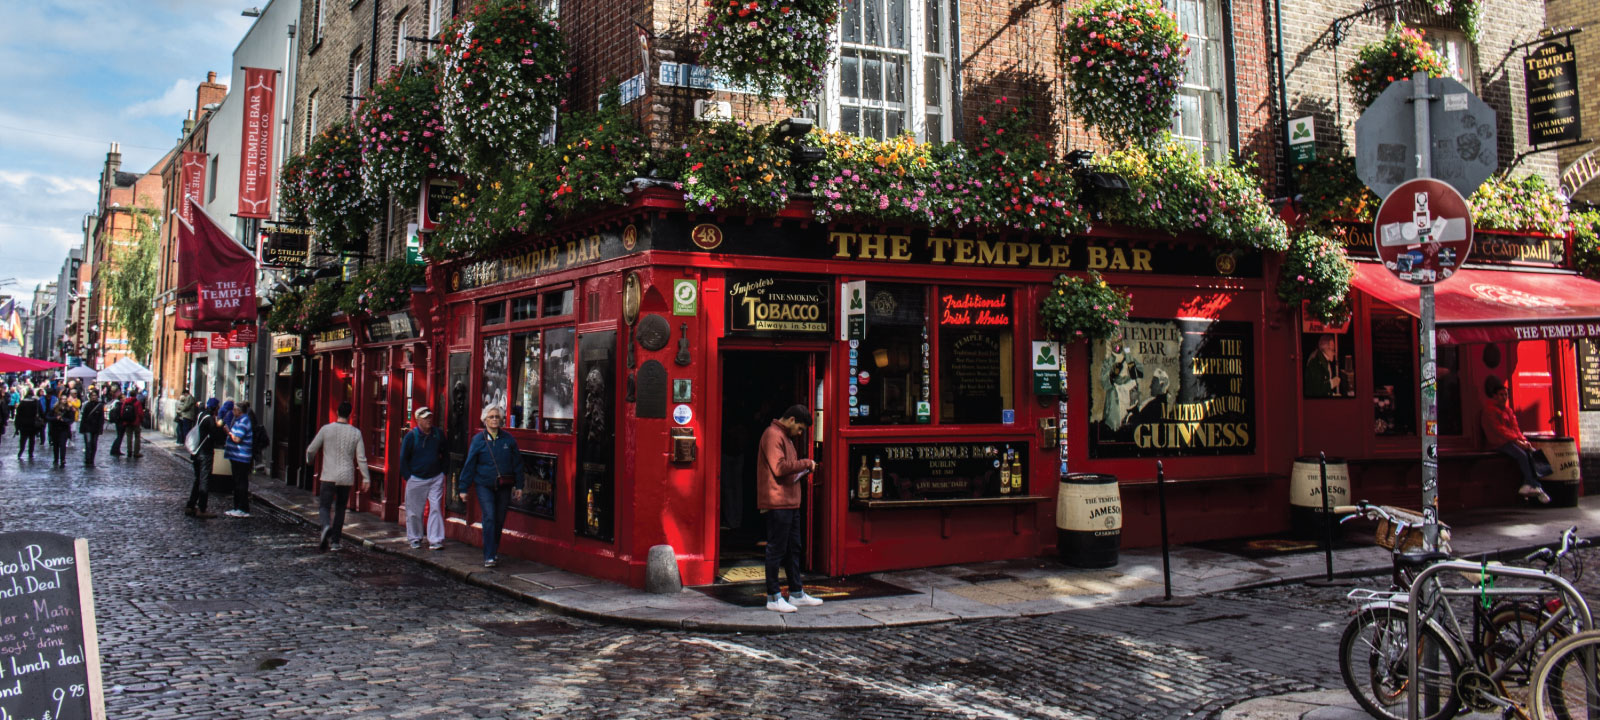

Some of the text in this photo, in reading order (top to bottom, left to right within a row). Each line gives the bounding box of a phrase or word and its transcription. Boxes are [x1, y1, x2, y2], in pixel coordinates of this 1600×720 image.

[1541, 46, 1556, 56] THE
[1526, 51, 1574, 71] TEMPLE
[1538, 67, 1563, 81] BAR
[1529, 89, 1575, 105] BEER GARDEN
[1533, 116, 1575, 130] LIVE MUSIC
[1542, 126, 1565, 136] DAILY
[246, 95, 260, 193] THE TEMPLE BAR
[259, 131, 268, 176] TRADING
[192, 170, 201, 188] THE
[1564, 154, 1600, 193] THE
[183, 183, 191, 217] TRDING
[698, 228, 716, 243] 48
[270, 248, 309, 257] DSTILLER
[503, 246, 560, 279] TEMPLE
[566, 234, 600, 266] BAR
[829, 232, 1153, 271] THE TEMPLE BAR
[216, 281, 237, 289] THE
[730, 278, 774, 296] Importers
[201, 287, 251, 300] TEMPLE
[769, 293, 819, 302] FINE SMOKING
[942, 293, 1007, 309] Traditional
[215, 299, 240, 309] BAR
[741, 296, 819, 326] TOBACCO
[941, 309, 1009, 325] Irish Music
[757, 321, 787, 331] Always
[801, 322, 825, 330] Stock
[1120, 327, 1178, 341] TEMPLE
[1514, 326, 1539, 339] THE
[1540, 324, 1586, 338] TEMPLE
[1139, 342, 1166, 356] BAR
[1220, 339, 1242, 356] THE
[1192, 357, 1242, 375] EMPEROR
[1230, 378, 1242, 394] OF
[1161, 395, 1247, 421] MALTED LIQUORS
[1133, 422, 1249, 448] GUINNESS
[885, 446, 914, 460] THE
[916, 446, 969, 460] TEMPLE
[930, 460, 956, 468] DUBLIN
[1310, 485, 1347, 497] JAESON
[1089, 505, 1121, 520] JAMESO
[25, 544, 74, 571] Rome
[25, 571, 60, 593] Deal
[0, 613, 17, 627] er
[34, 599, 74, 621] Main
[23, 626, 36, 641] of
[44, 624, 69, 634] wine
[1, 637, 64, 655] soft drink
[11, 652, 50, 676] lunch
[58, 644, 85, 666] deal
